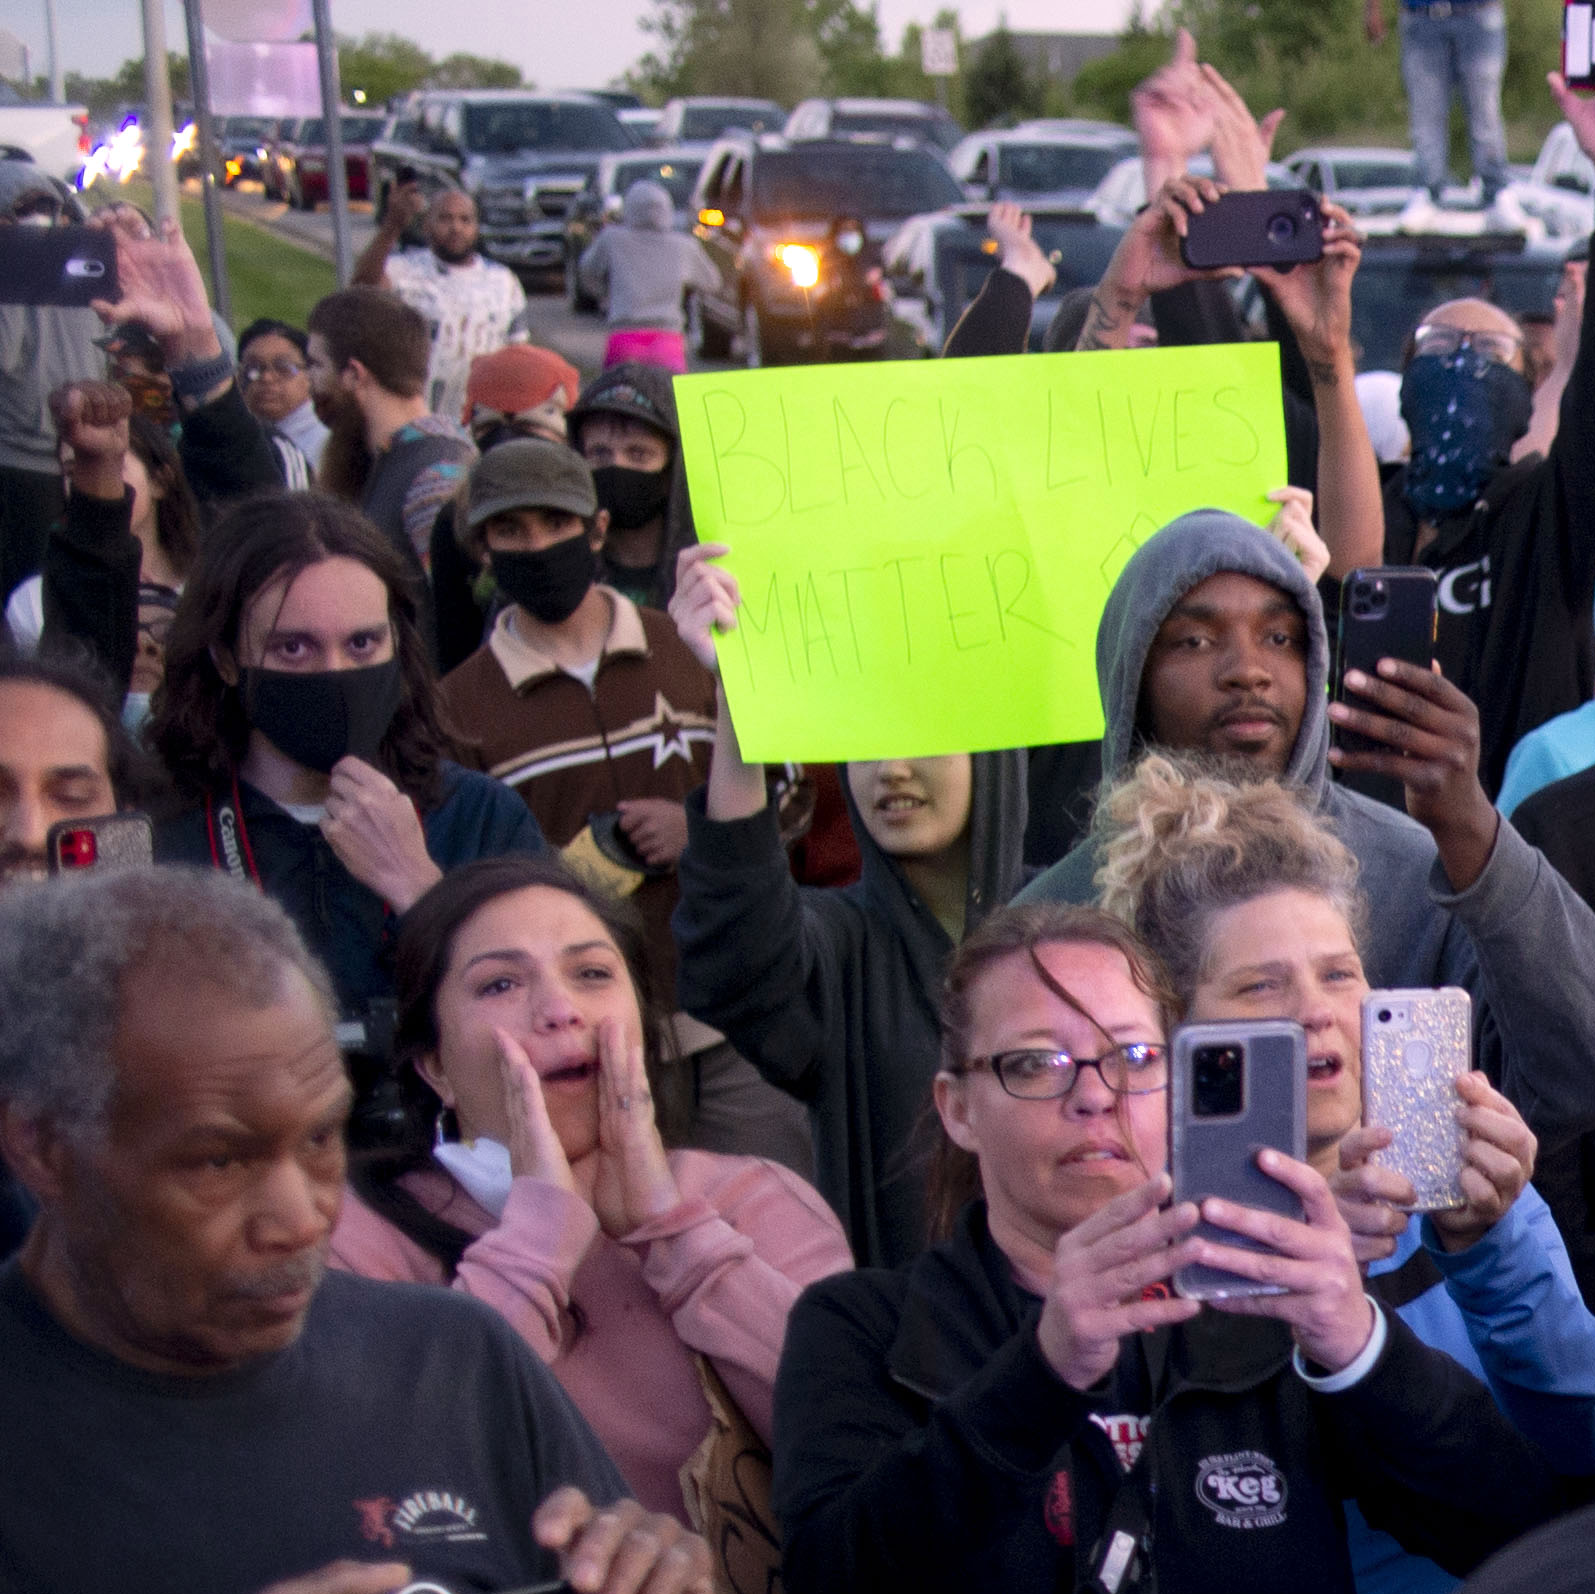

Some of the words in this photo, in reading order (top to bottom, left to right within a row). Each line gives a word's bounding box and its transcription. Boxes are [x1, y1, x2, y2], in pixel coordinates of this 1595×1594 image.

[702, 389, 998, 525] BLACK
[1046, 386, 1261, 491] LIVES
[734, 549, 1077, 692] MATTER
[219, 806, 246, 881] Canon
[394, 1490, 476, 1532] FIREBALL
[1207, 1474, 1281, 1505] Keg
